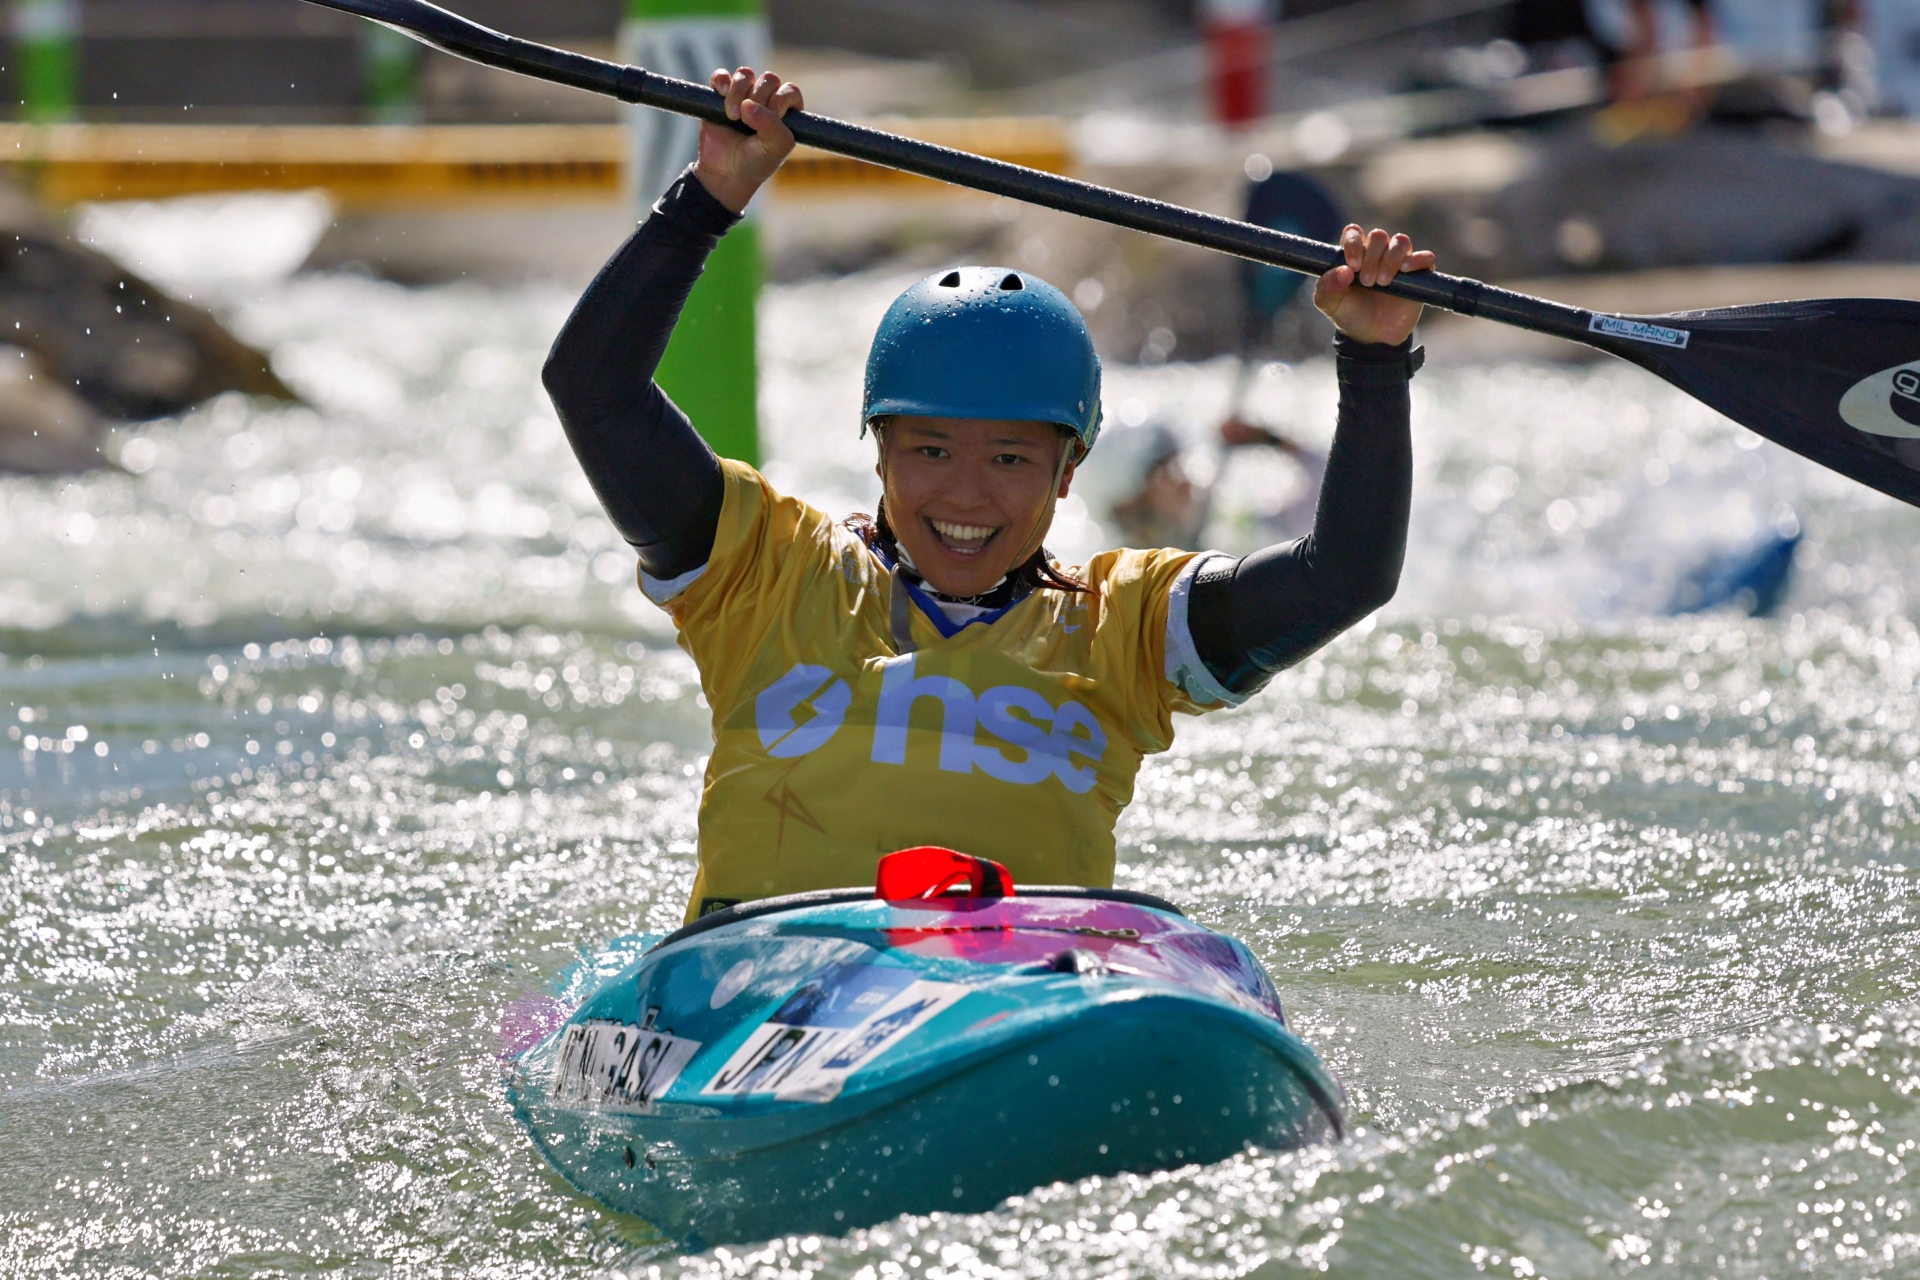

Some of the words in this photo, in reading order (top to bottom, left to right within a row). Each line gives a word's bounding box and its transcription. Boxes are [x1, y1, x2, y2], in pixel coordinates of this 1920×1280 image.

[1604, 318, 1628, 331] MIL
[1632, 323, 1676, 340] MANO
[870, 652, 1108, 794] hse
[713, 1027, 840, 1091] JPN
